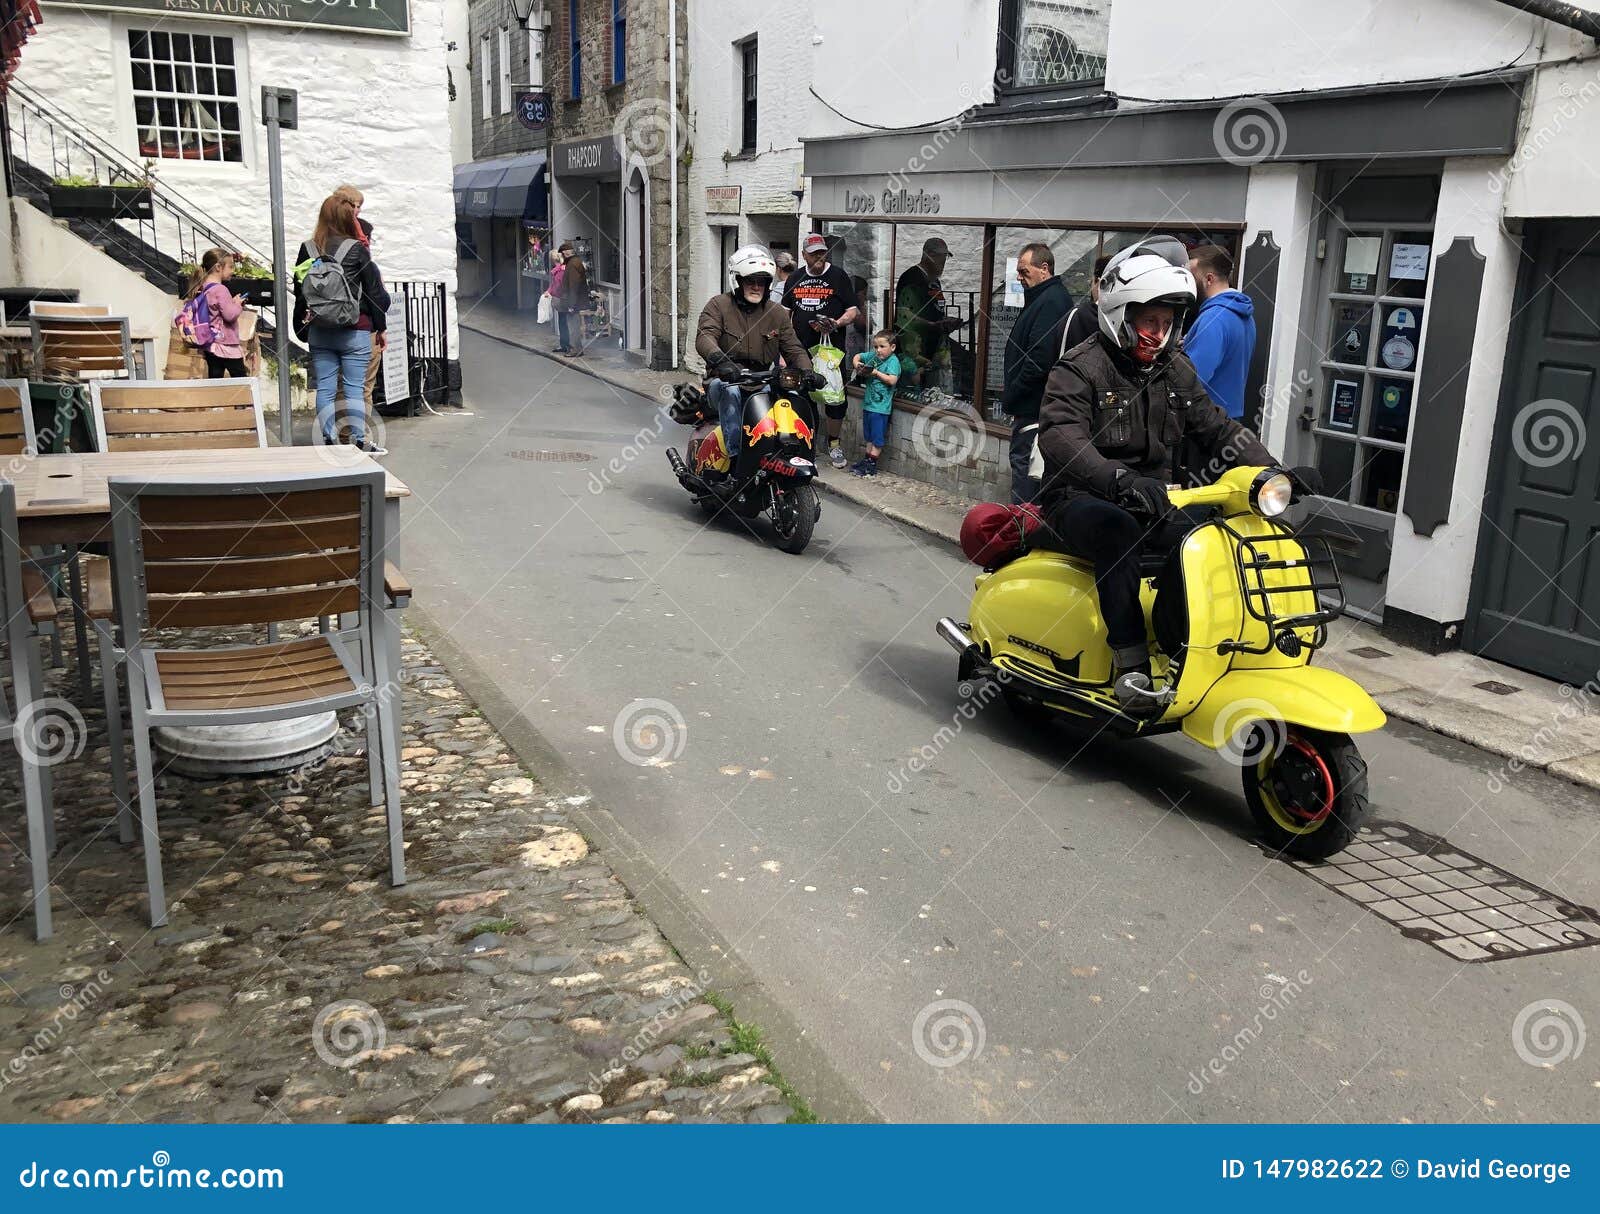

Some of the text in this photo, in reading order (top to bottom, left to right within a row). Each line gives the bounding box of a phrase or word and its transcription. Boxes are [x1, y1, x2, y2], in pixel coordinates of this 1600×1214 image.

[165, 0, 293, 18] RESTAURANT
[567, 143, 602, 169] RHAPSODY
[845, 188, 940, 214] Looe Galleries
